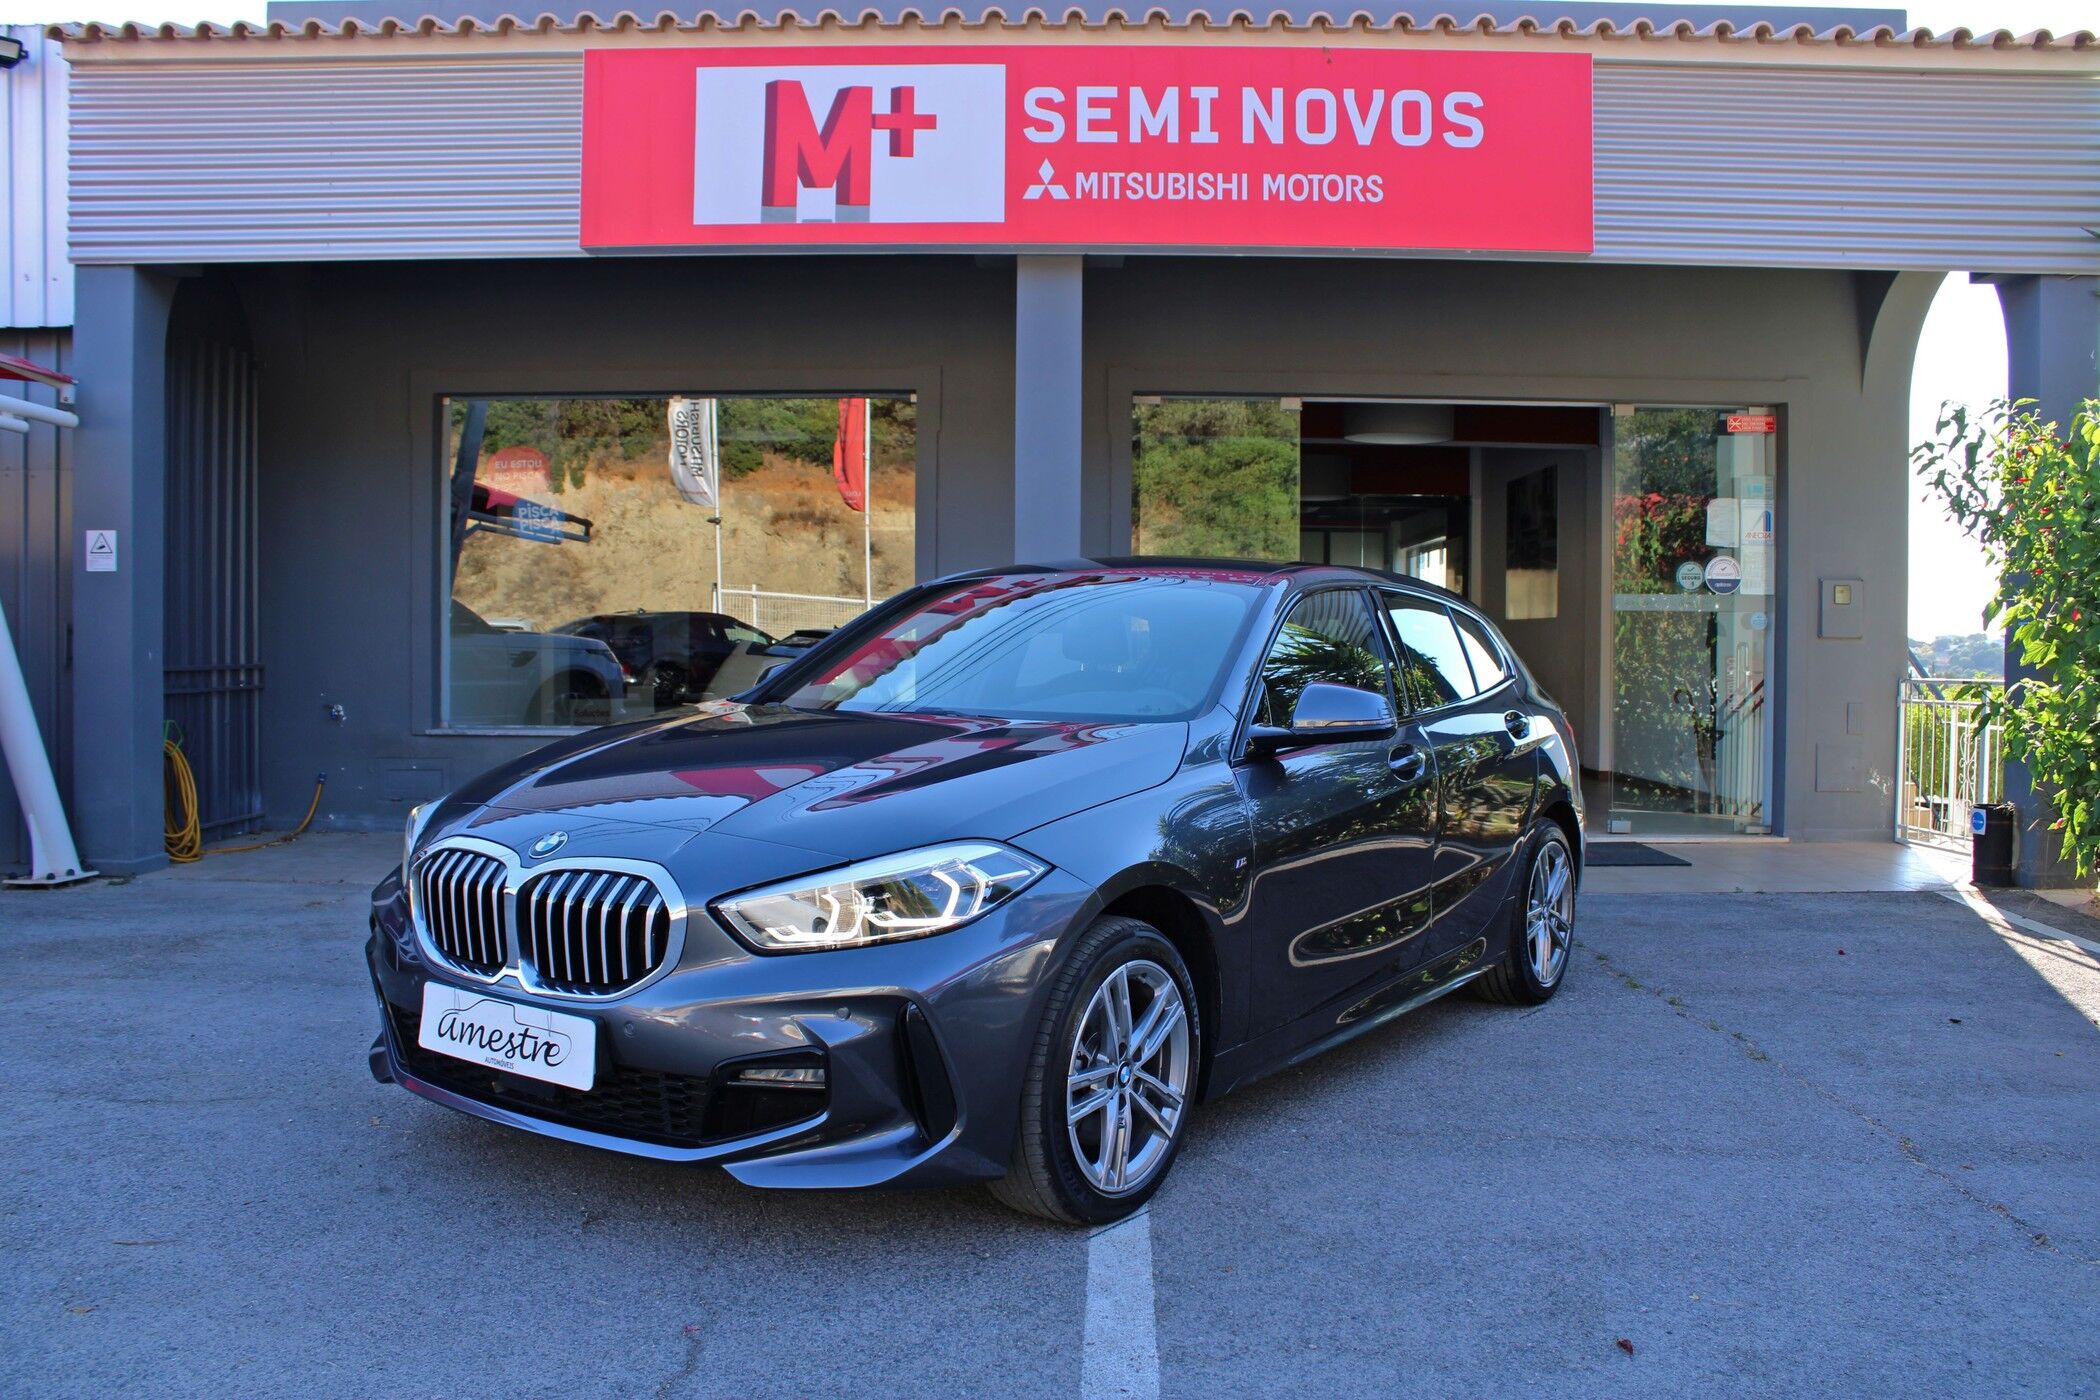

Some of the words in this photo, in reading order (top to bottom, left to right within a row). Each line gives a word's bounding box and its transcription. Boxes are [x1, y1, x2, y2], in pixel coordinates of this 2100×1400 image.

[1024, 87, 1218, 143] SEMI
[1243, 87, 1483, 147] NOVOS
[1076, 173, 1247, 200] MITSUBISHI
[1264, 174, 1383, 202] MOTORS
[438, 1012, 562, 1067] amestre
